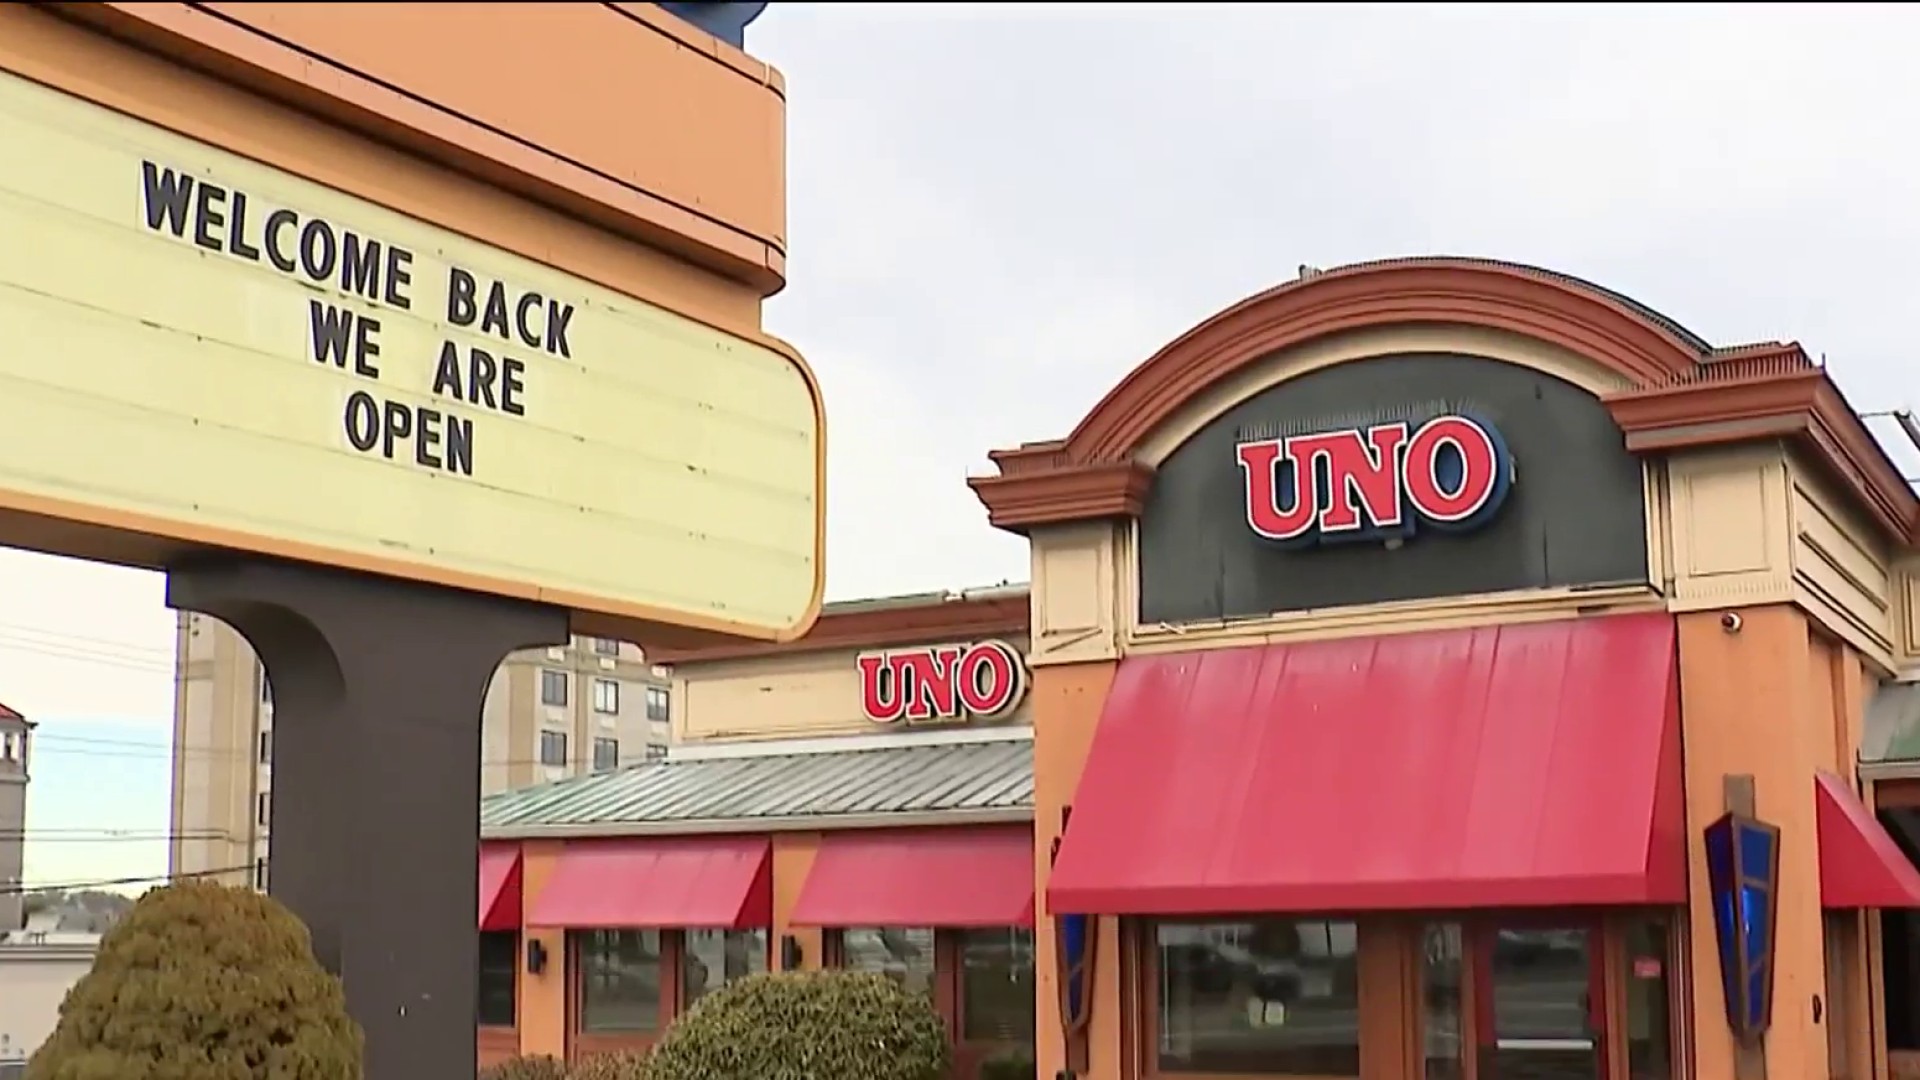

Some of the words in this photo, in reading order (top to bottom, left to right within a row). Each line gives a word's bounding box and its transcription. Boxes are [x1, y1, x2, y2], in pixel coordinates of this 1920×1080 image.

[143, 160, 413, 310] WELCOME
[447, 266, 574, 358] BACK
[309, 300, 381, 379] WE
[432, 341, 525, 416] ARE
[345, 391, 473, 476] OPEN
[1236, 414, 1498, 540] UNO
[857, 640, 1017, 722] UNO
